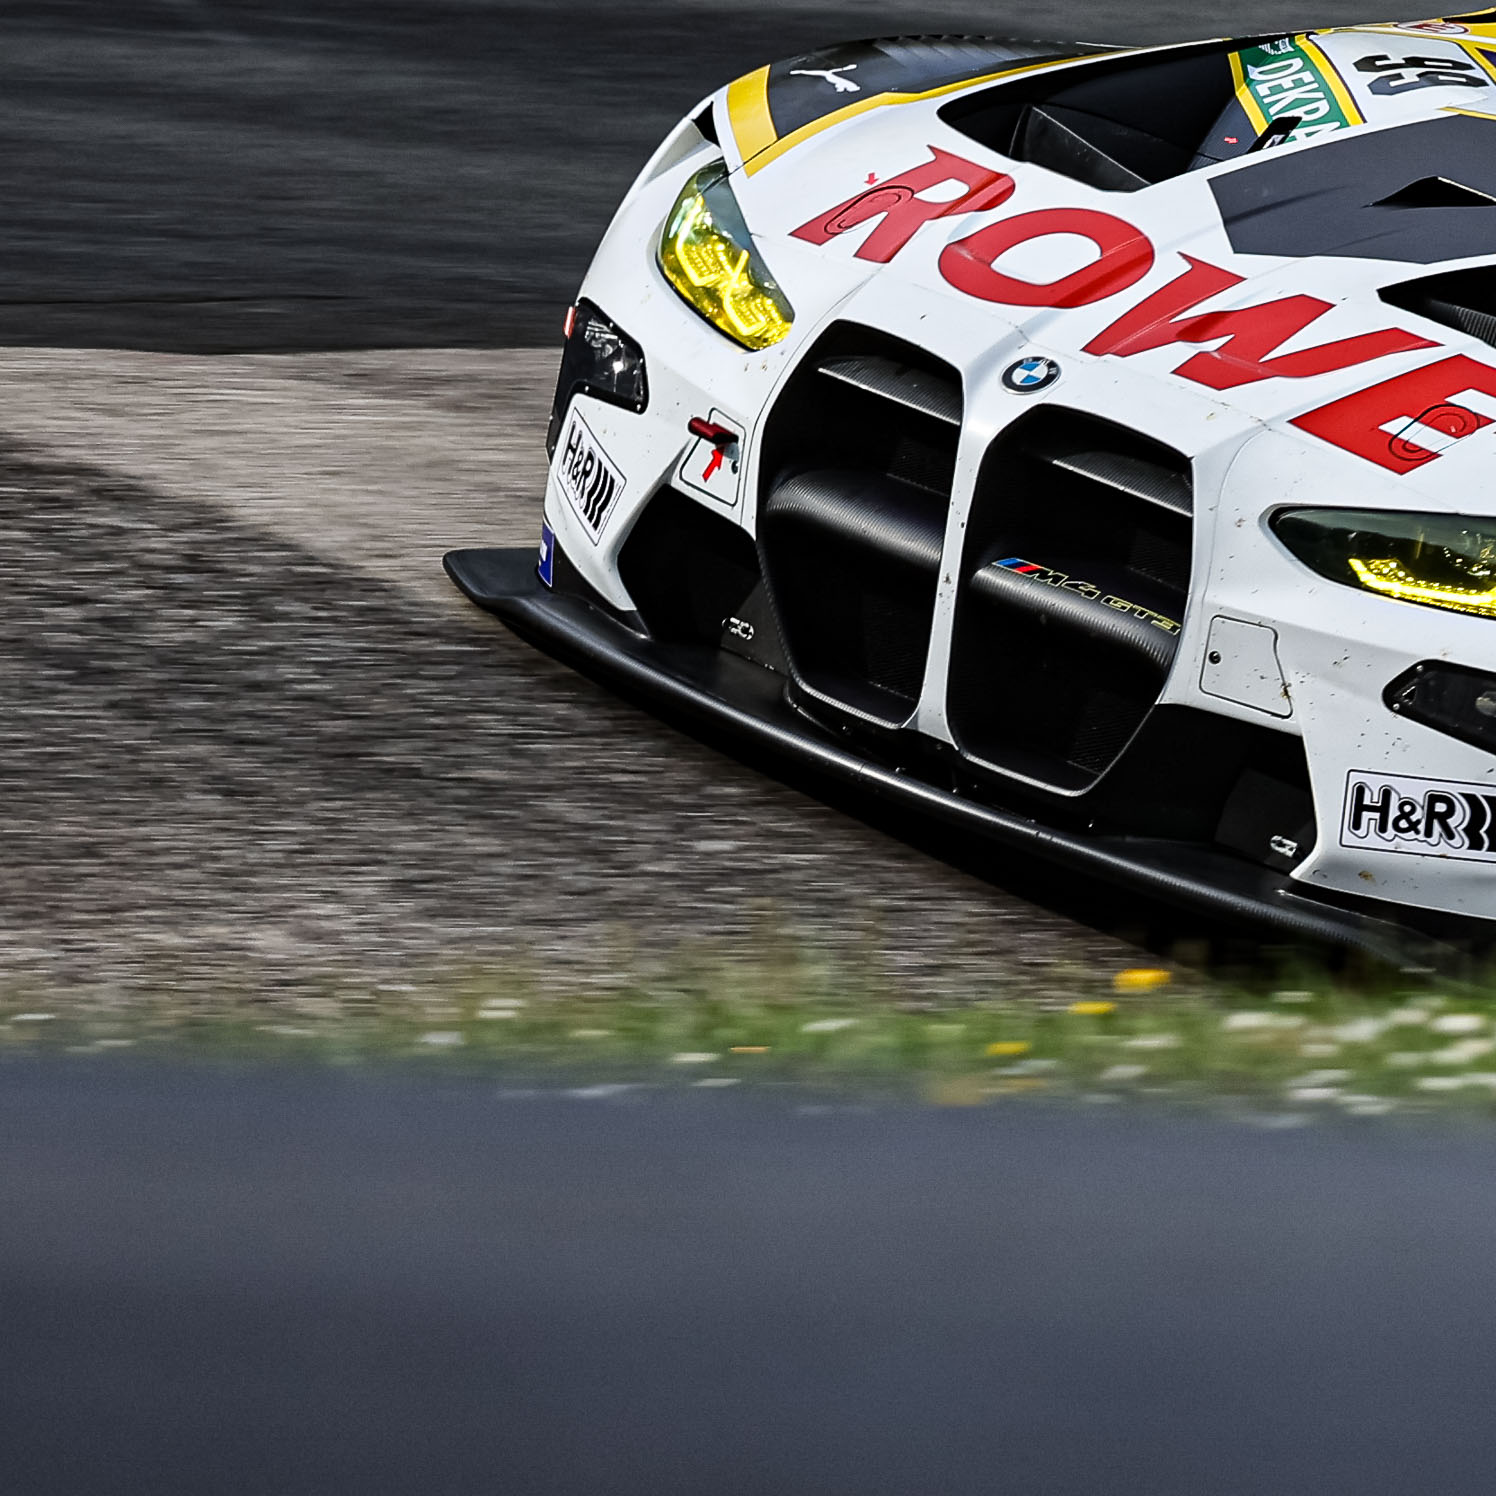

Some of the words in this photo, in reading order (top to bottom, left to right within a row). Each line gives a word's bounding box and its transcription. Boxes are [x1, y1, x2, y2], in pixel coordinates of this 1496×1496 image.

[1350, 53, 1490, 97] 99
[1101, 595, 1182, 636] GT3
[1349, 782, 1461, 844] H&R
